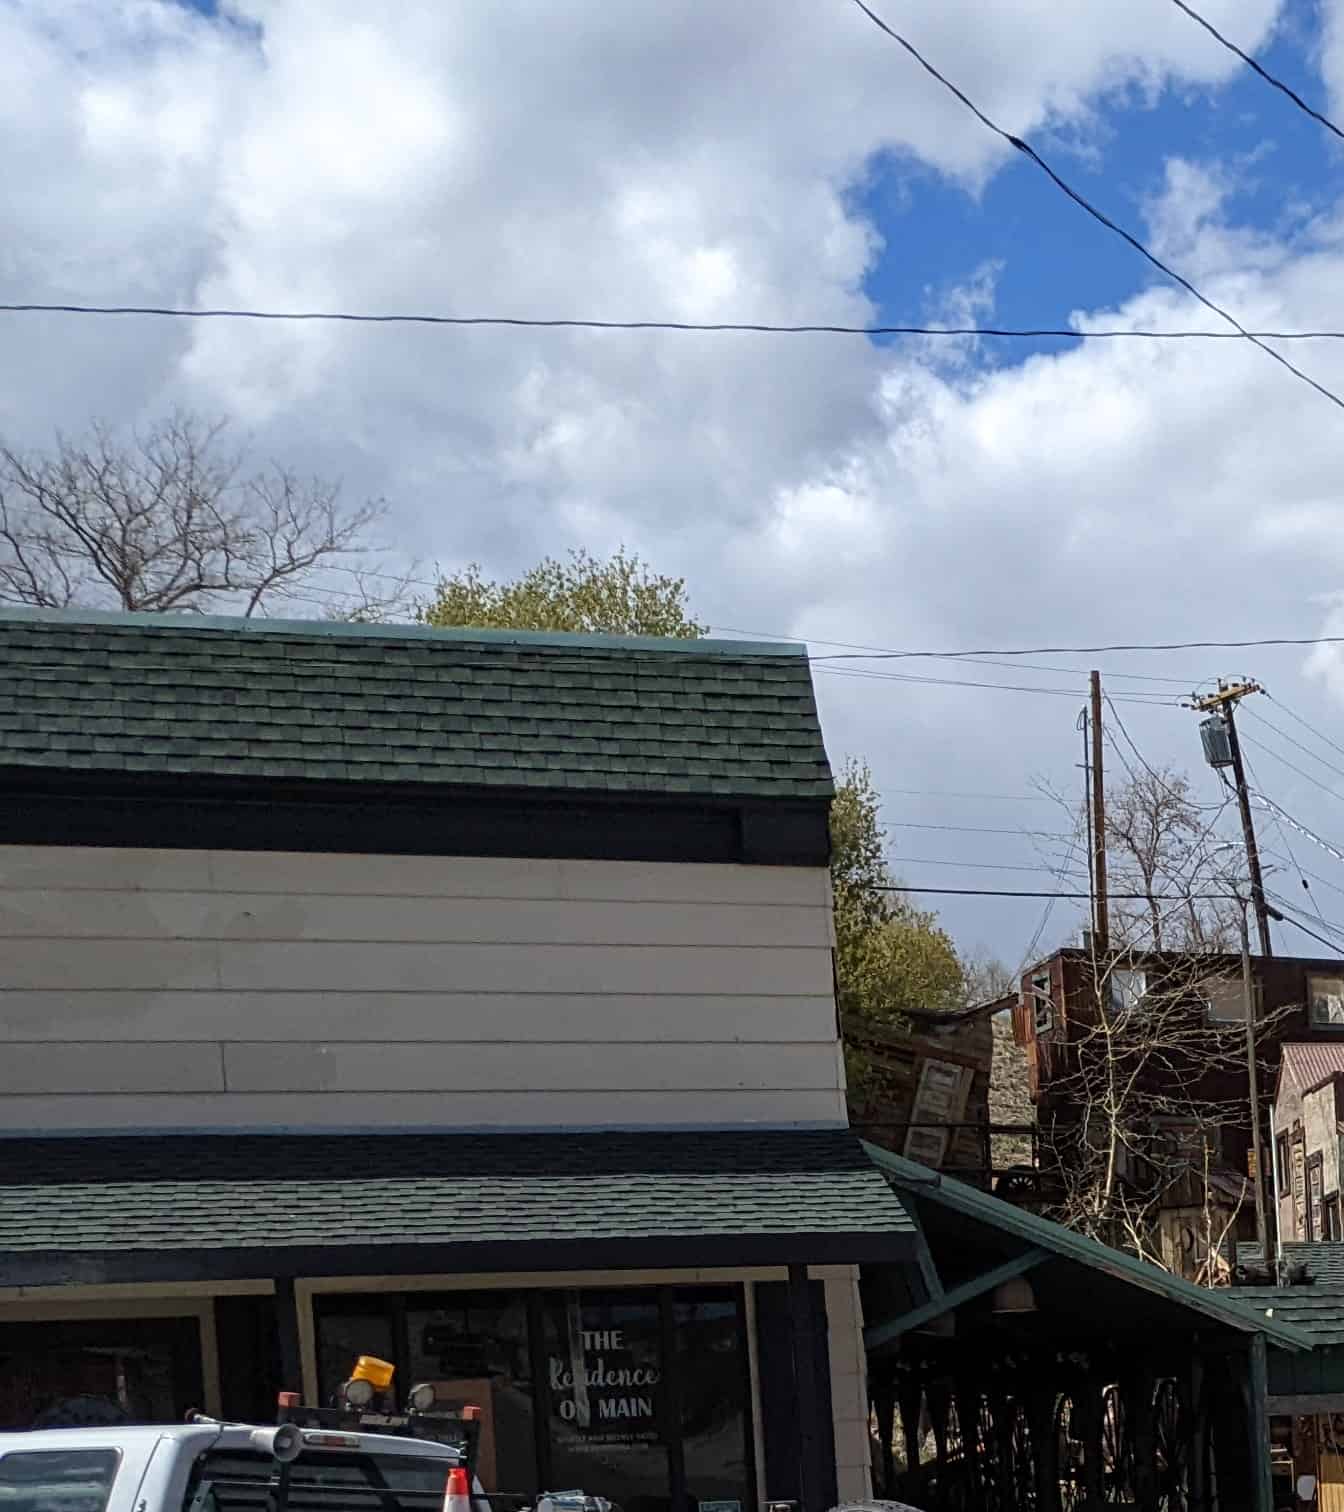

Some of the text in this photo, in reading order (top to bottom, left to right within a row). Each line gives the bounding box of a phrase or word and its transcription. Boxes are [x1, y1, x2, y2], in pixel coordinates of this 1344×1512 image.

[578, 1330, 625, 1351] THE
[549, 1356, 659, 1390] Reidence
[560, 1398, 652, 1421] ON MAIN
